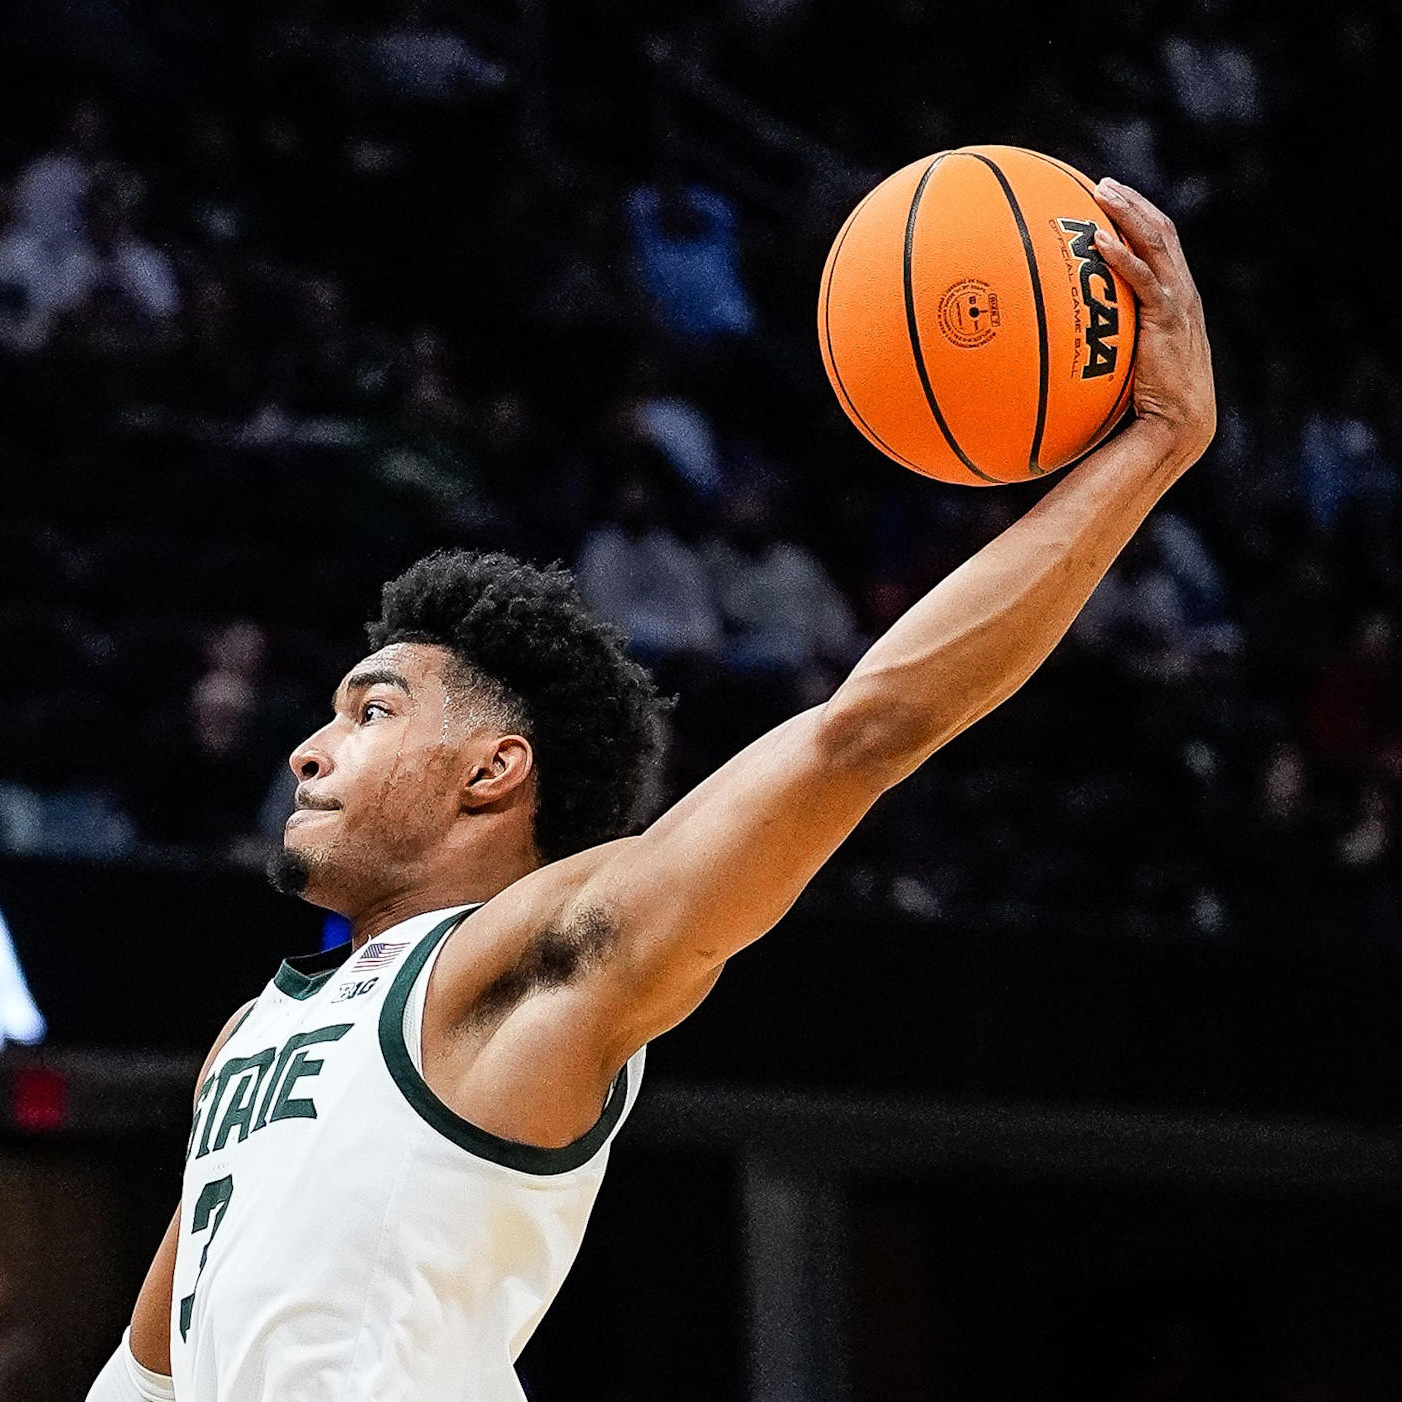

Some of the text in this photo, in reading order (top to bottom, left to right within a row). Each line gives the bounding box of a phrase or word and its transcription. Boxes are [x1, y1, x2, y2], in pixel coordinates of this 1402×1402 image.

[1057, 218, 1119, 379] NCAA
[1071, 287, 1082, 333] GAME
[1070, 338, 1081, 379] BALL
